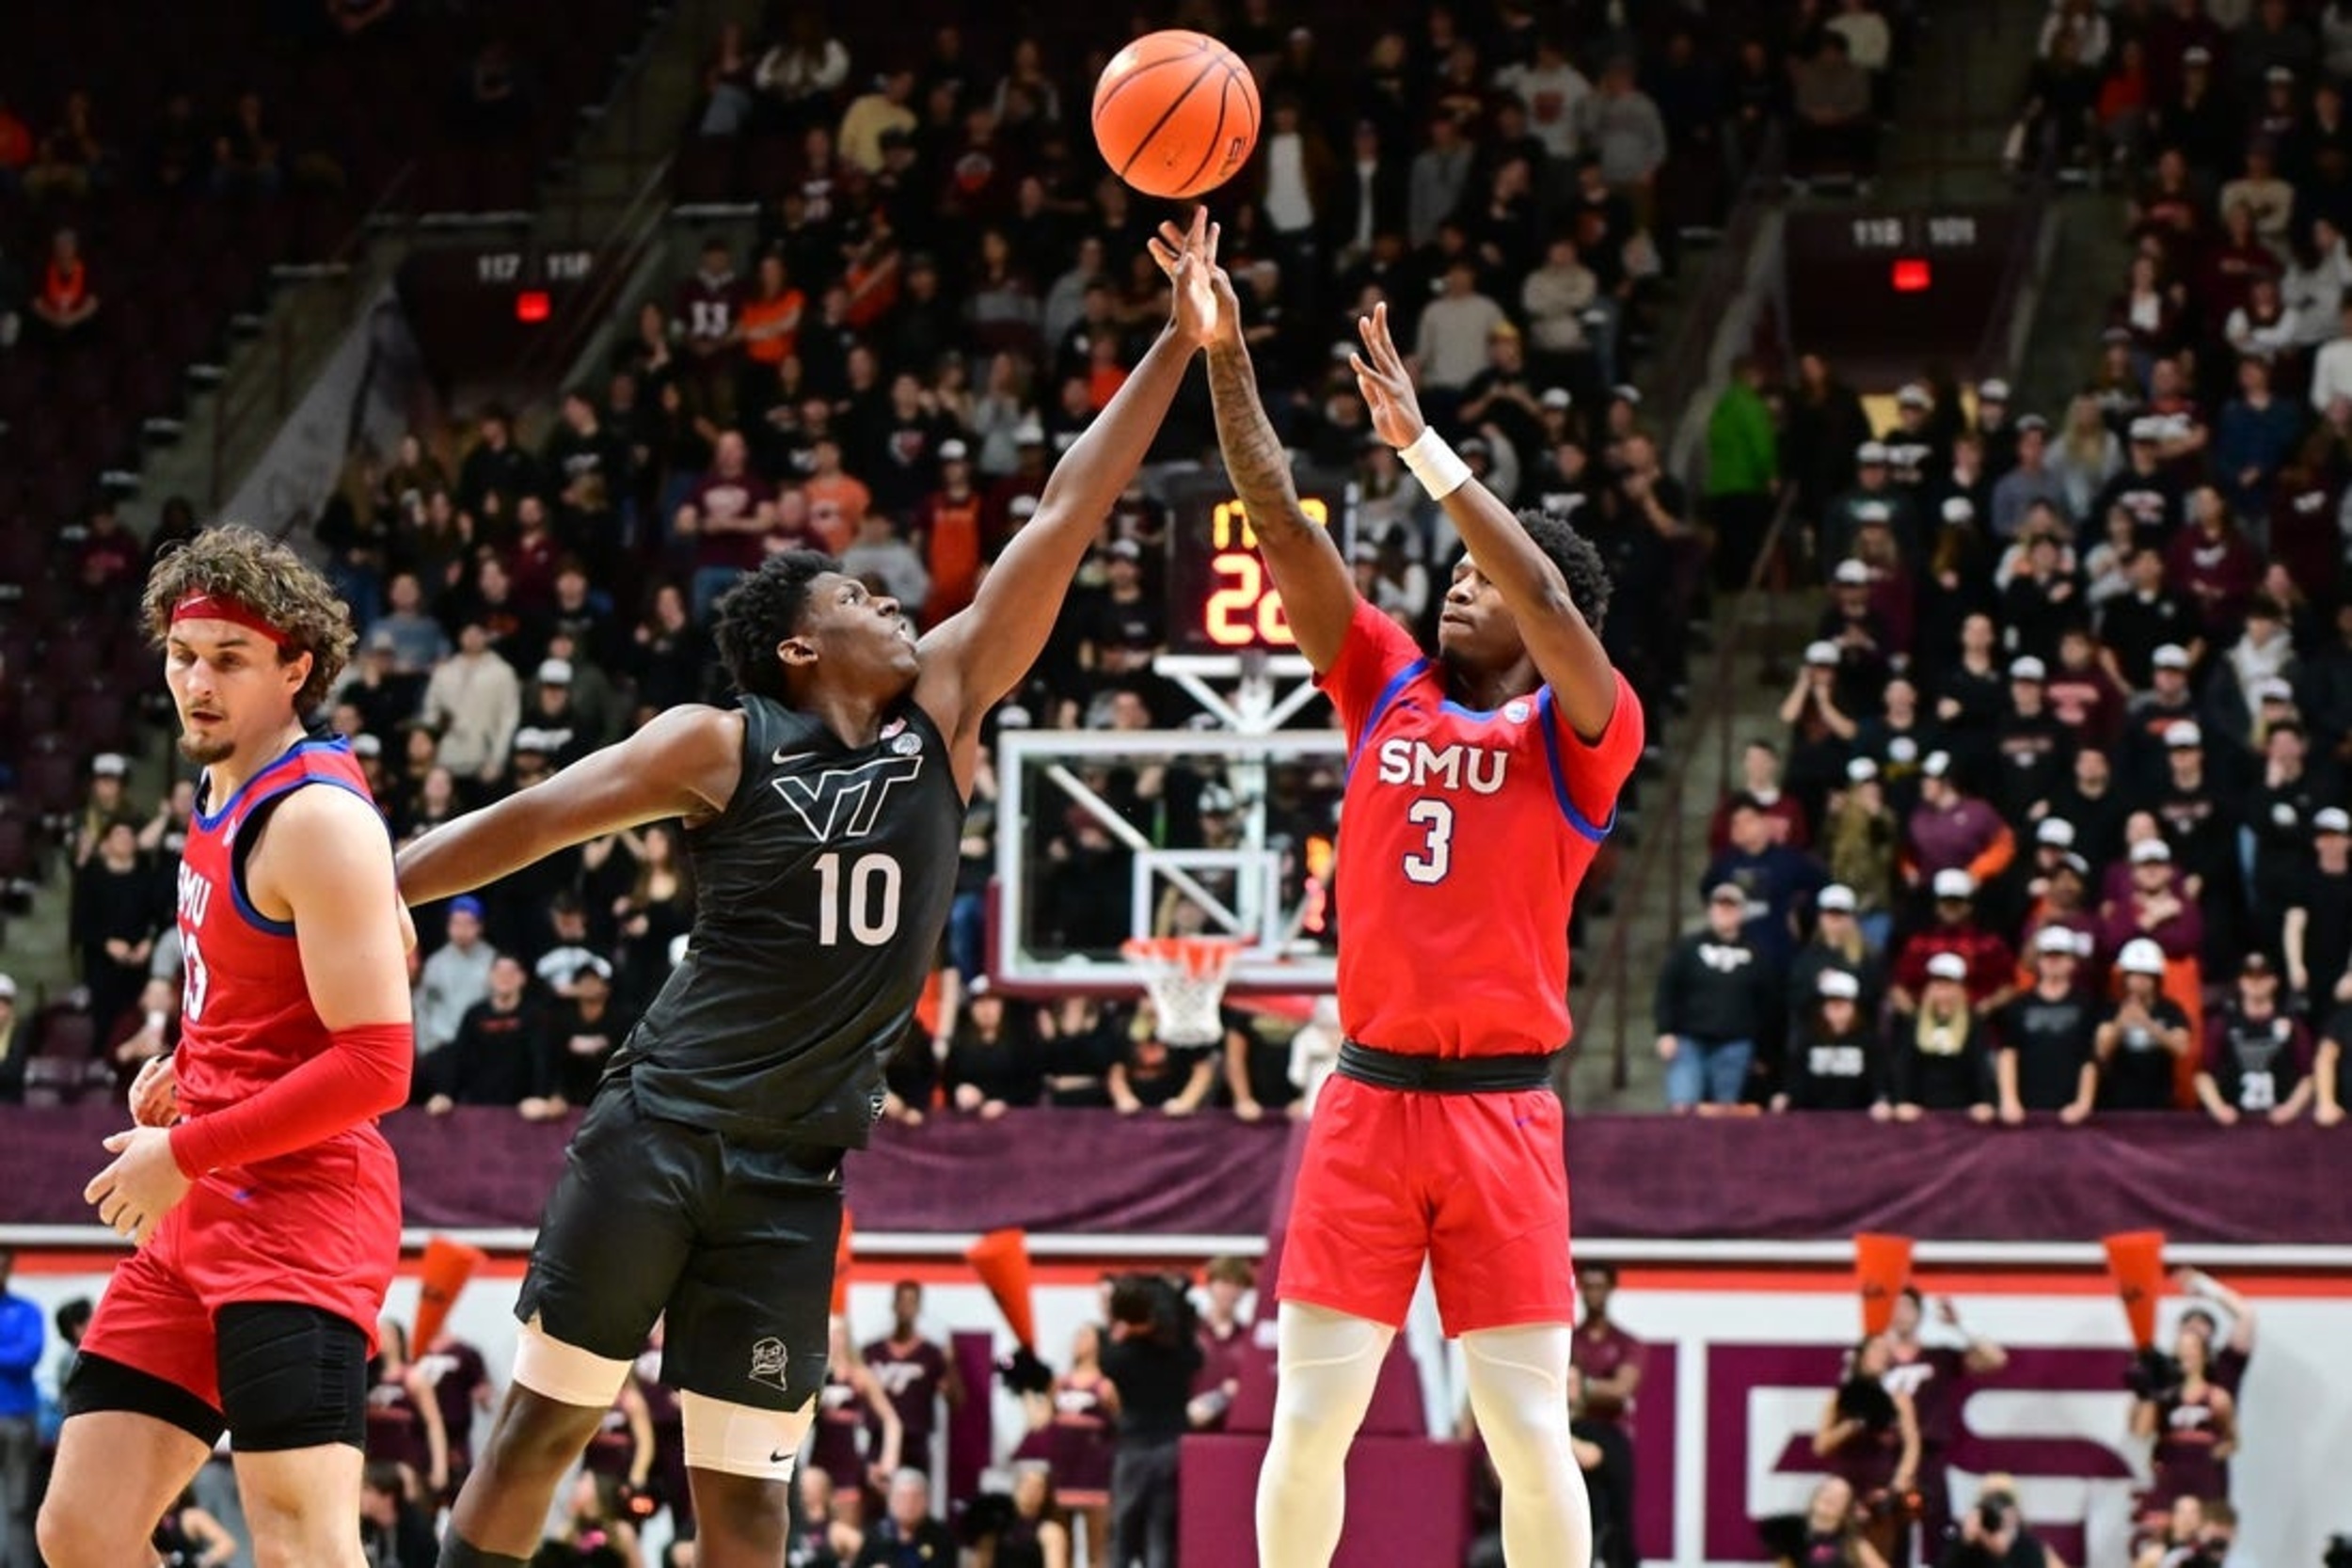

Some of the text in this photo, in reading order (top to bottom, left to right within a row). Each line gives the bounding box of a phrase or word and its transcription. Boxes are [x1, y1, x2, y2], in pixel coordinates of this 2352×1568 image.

[771, 755, 924, 842] VT
[1379, 737, 1508, 795] SMU
[1405, 798, 1455, 885] 3
[813, 852, 902, 946] 10
